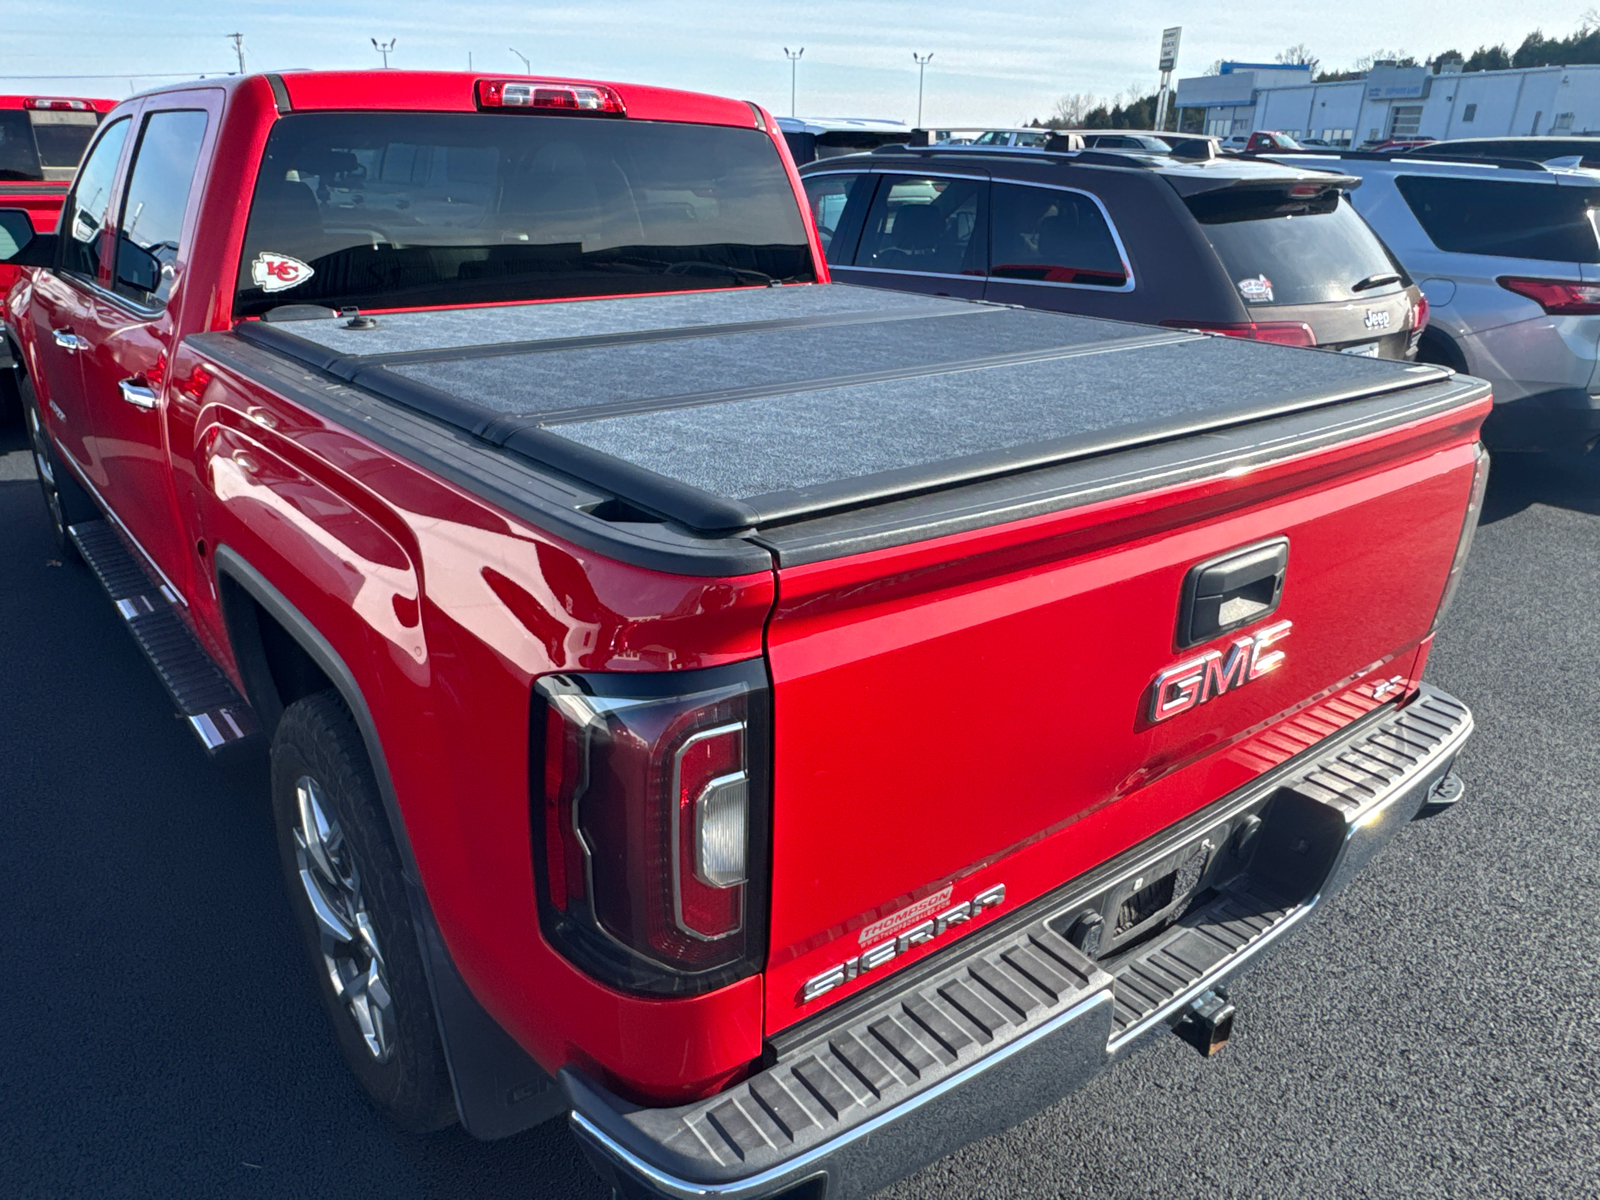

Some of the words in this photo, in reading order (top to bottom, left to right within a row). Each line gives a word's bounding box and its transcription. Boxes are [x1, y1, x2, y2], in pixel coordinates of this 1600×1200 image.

[266, 261, 299, 281] KC
[1364, 309, 1390, 328] Jeep
[1149, 619, 1293, 723] GMC
[863, 889, 950, 938] THOMPSON
[797, 883, 1005, 1005] SIERRA
